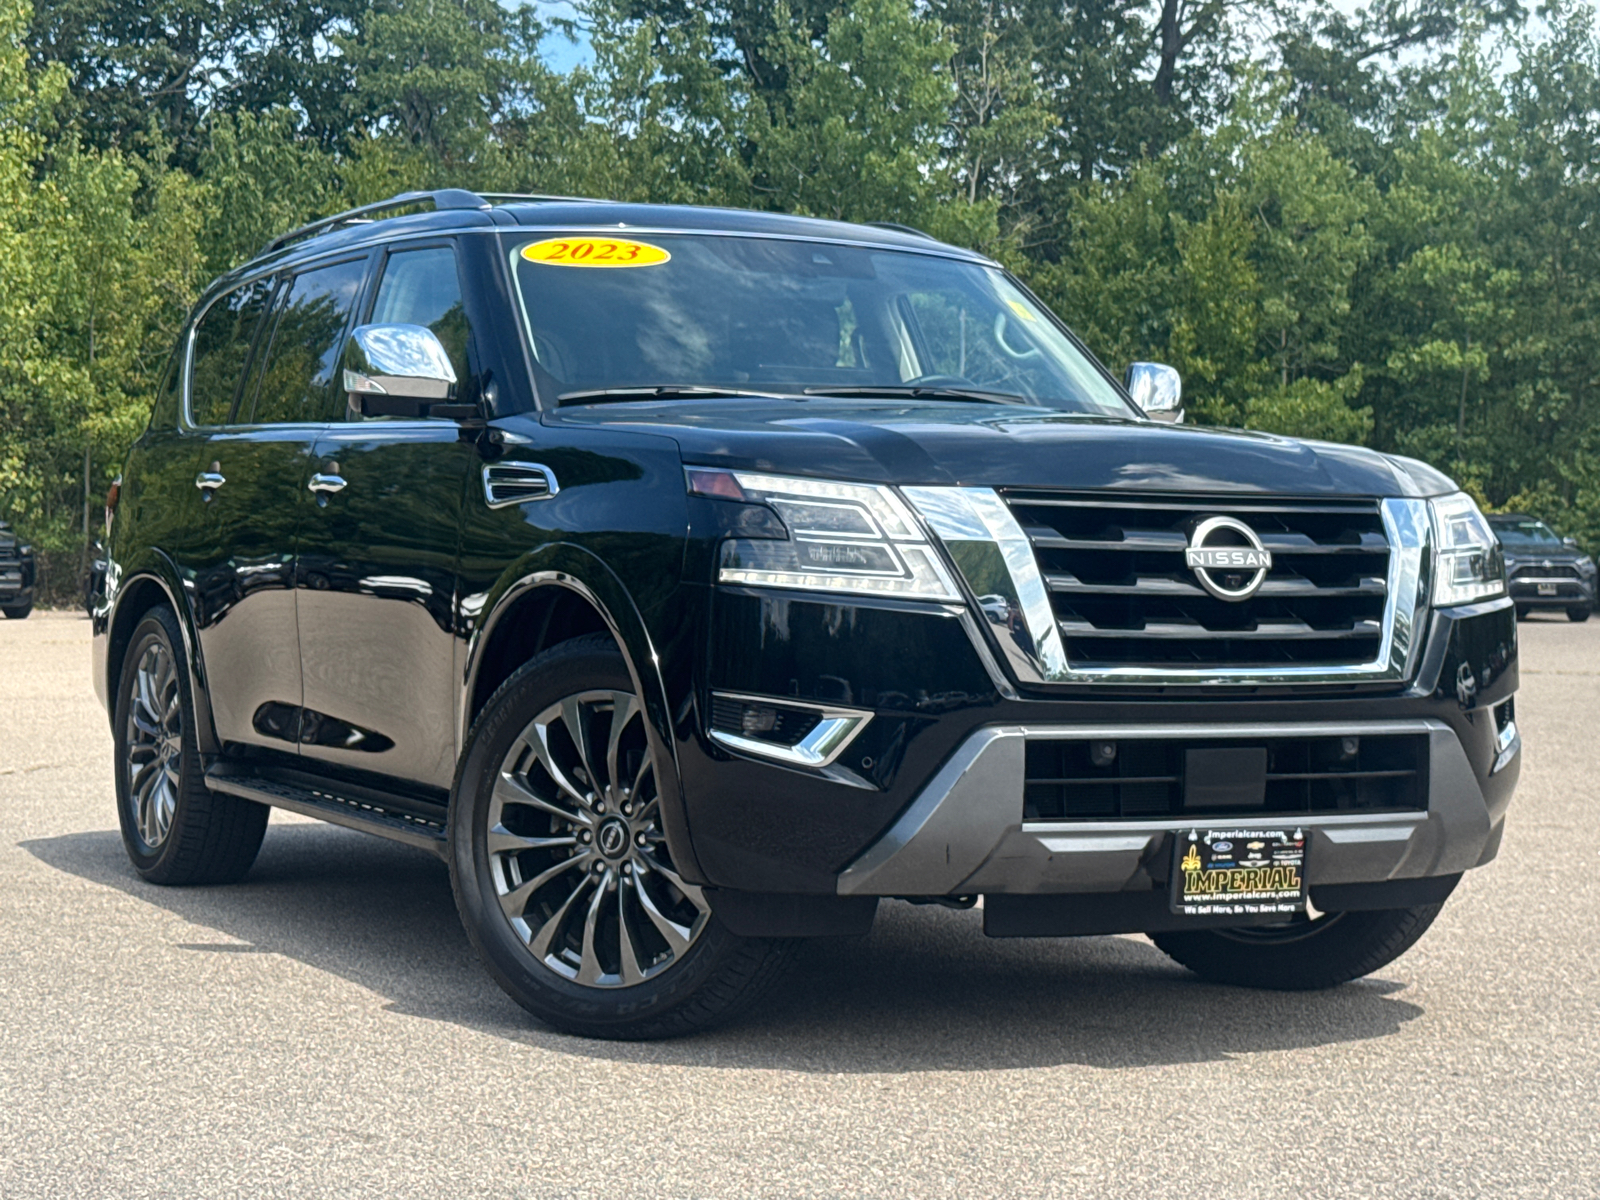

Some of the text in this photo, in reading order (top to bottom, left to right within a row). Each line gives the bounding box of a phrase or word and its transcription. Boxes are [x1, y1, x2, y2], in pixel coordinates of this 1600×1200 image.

[545, 243, 641, 260] 2023
[1189, 551, 1270, 566] NISSAN
[1184, 867, 1300, 893] IMPERIAL
[1184, 906, 1197, 914] We
[1198, 905, 1211, 914] Sell
[1234, 905, 1243, 913] So
[1245, 905, 1258, 913] You
[1260, 905, 1276, 913] Save
[1278, 904, 1295, 912] More
